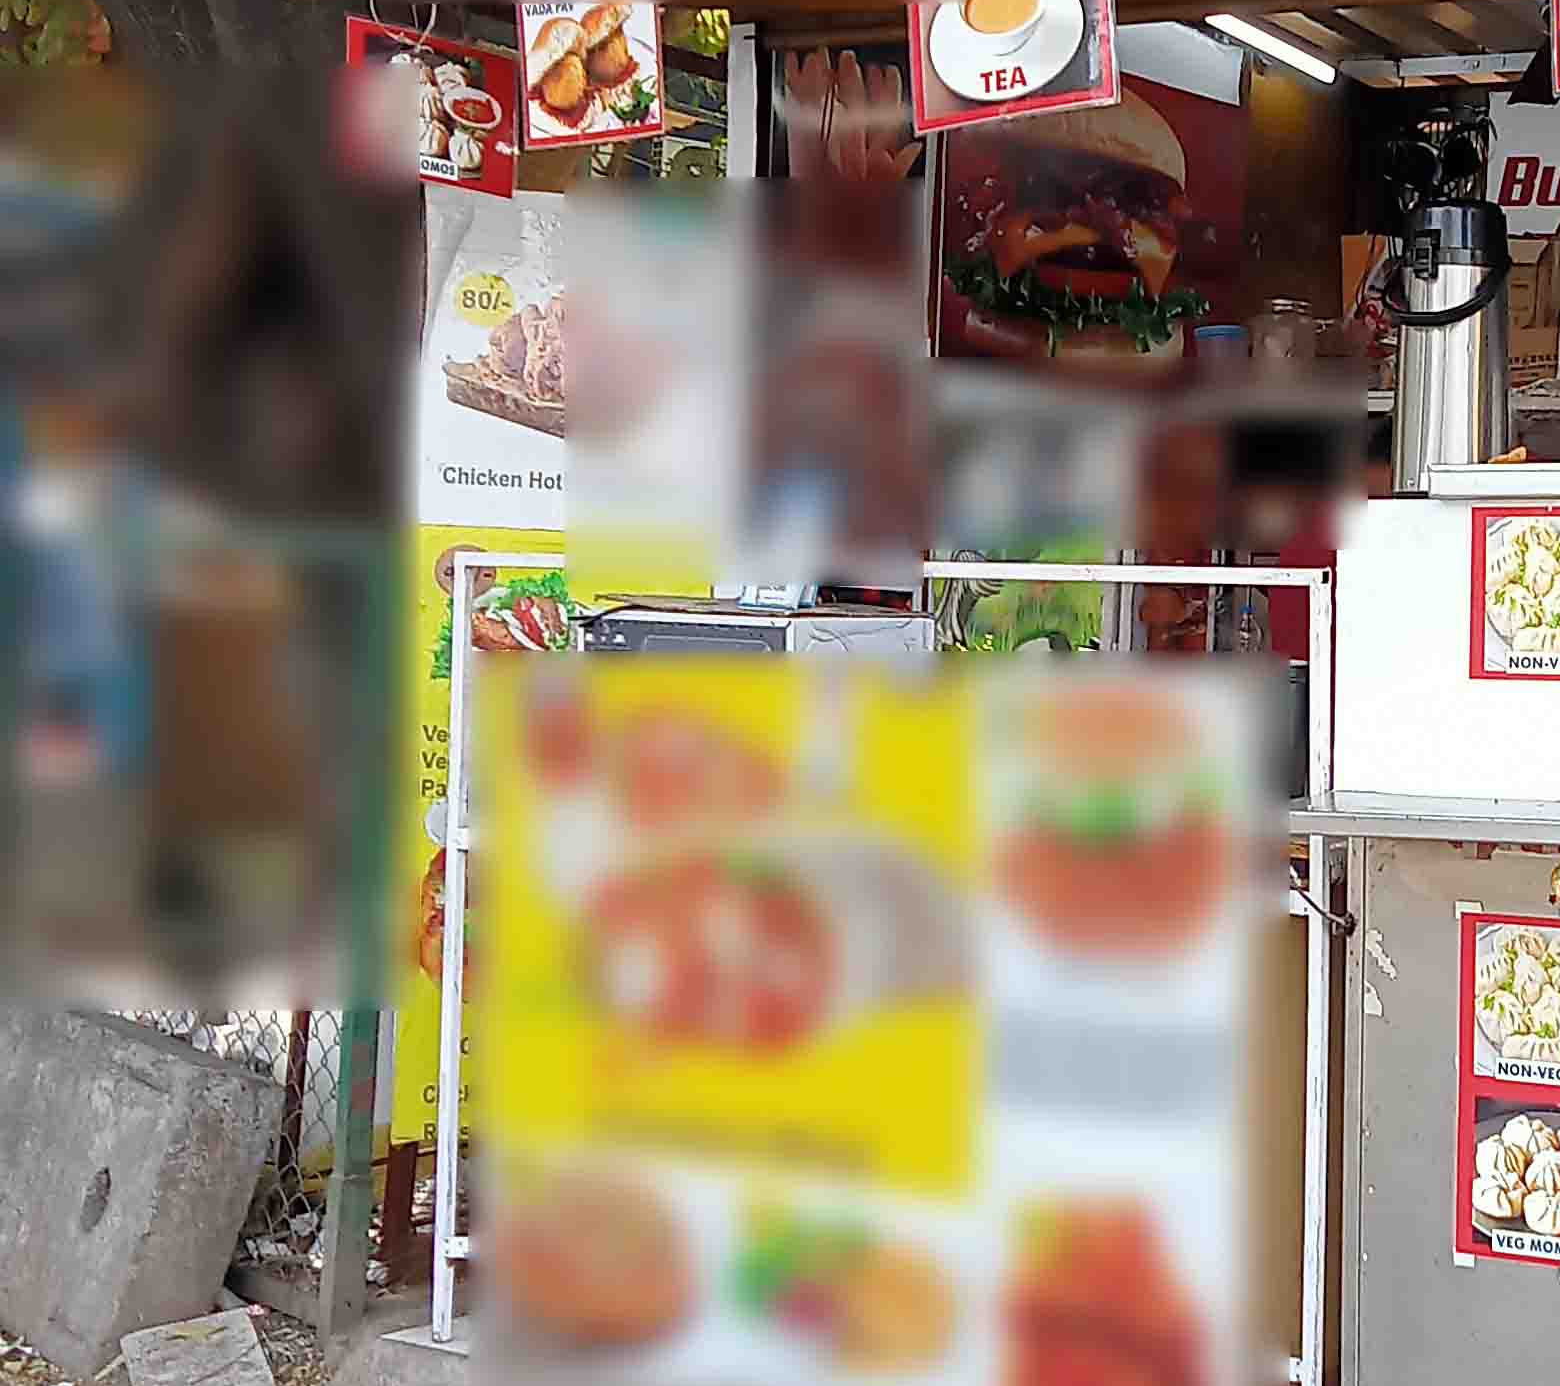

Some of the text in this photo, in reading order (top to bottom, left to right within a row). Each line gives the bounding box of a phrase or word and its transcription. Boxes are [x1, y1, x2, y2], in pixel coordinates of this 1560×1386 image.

[979, 64, 1029, 94] TEA
[420, 158, 455, 176] OMOS
[442, 466, 564, 491] Chicken Hot
[1496, 1233, 1526, 1251] VEG
